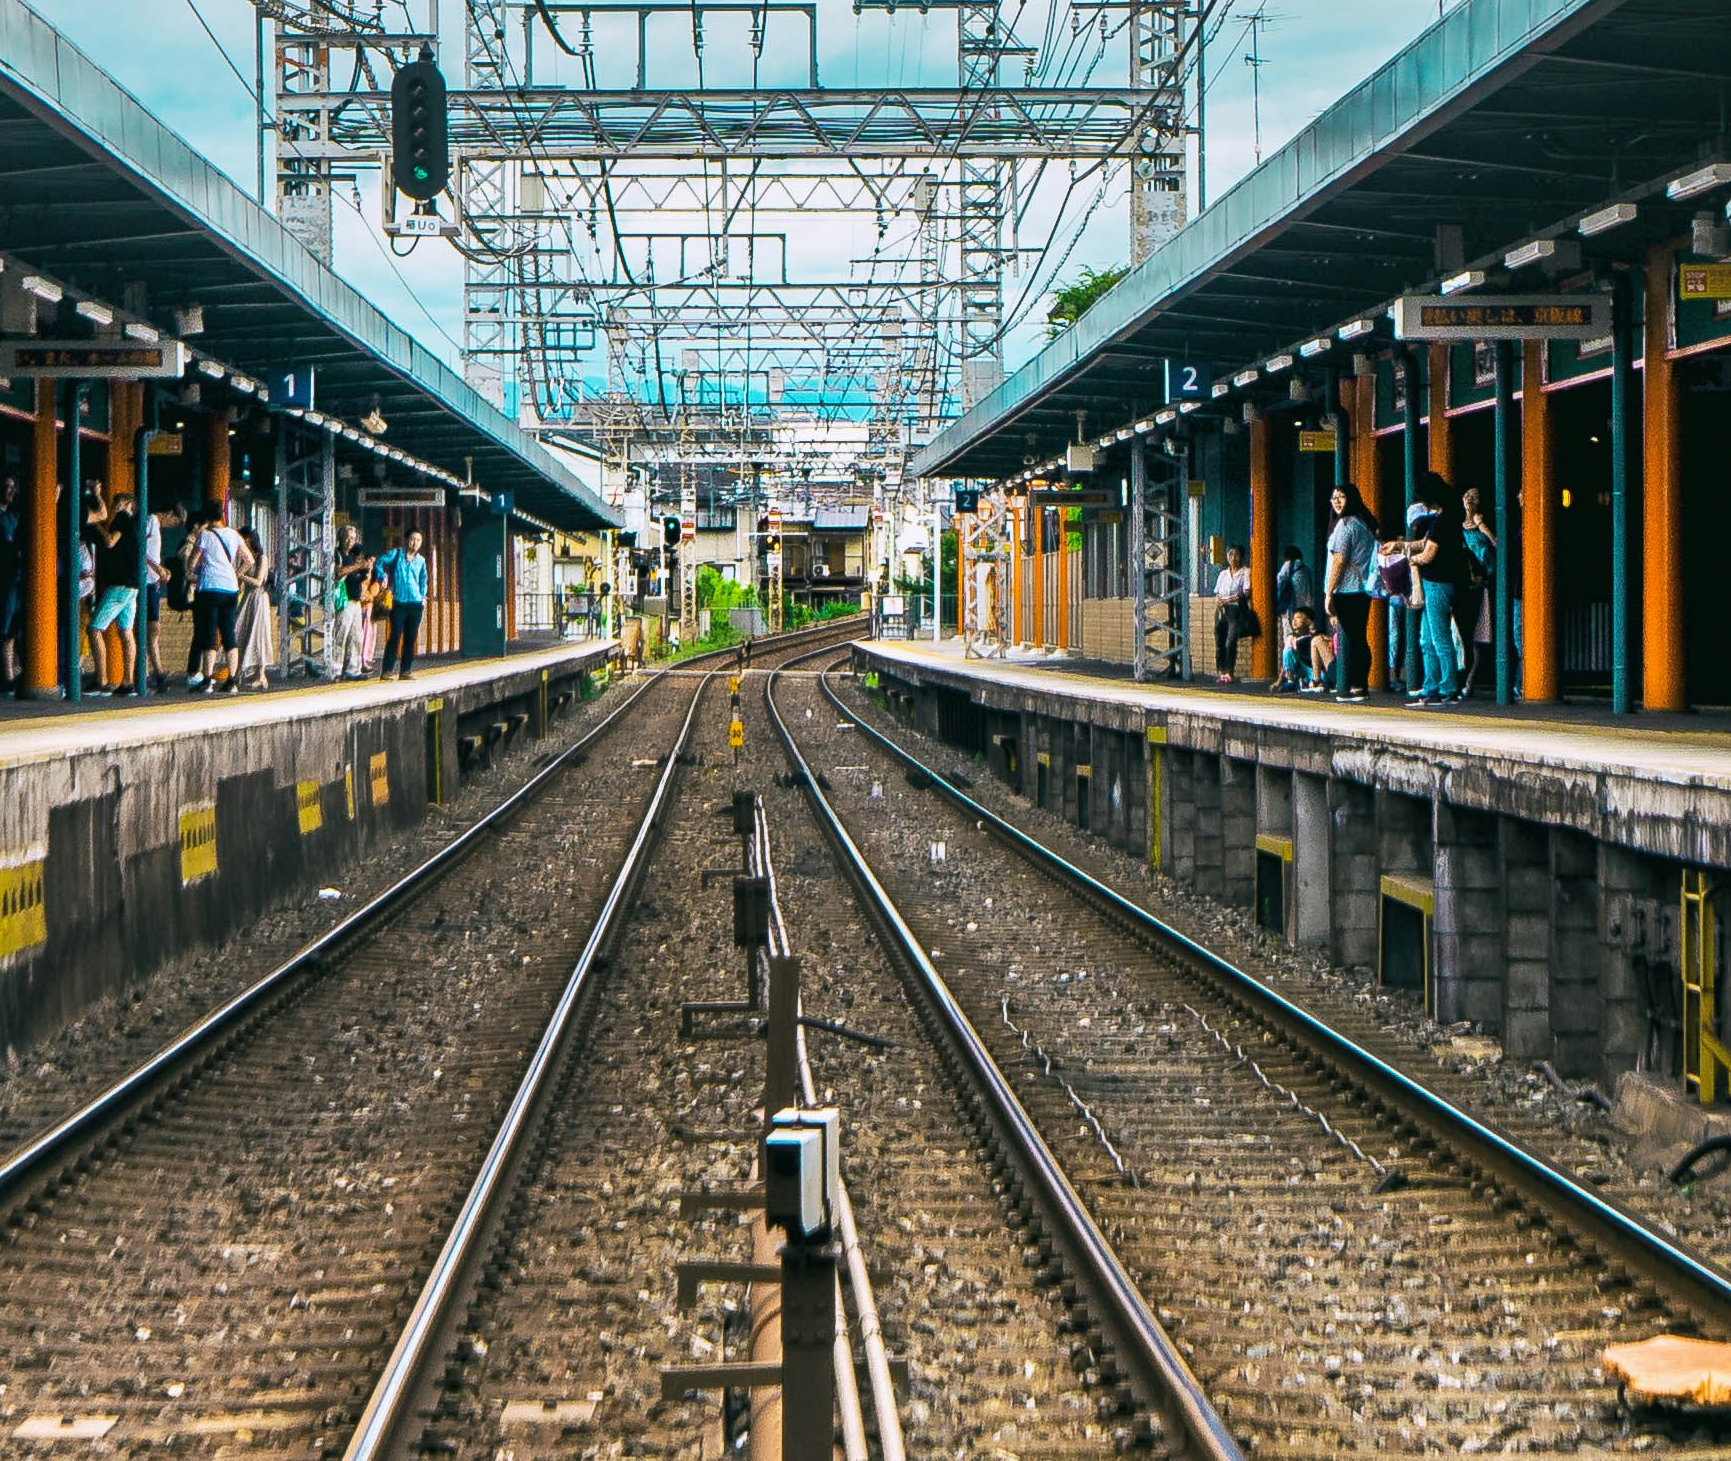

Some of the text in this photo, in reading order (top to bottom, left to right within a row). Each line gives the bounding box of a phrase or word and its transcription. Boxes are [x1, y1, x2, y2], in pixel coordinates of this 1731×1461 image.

[283, 373, 295, 397] 1
[1182, 366, 1198, 390] 2
[962, 494, 971, 507] 2
